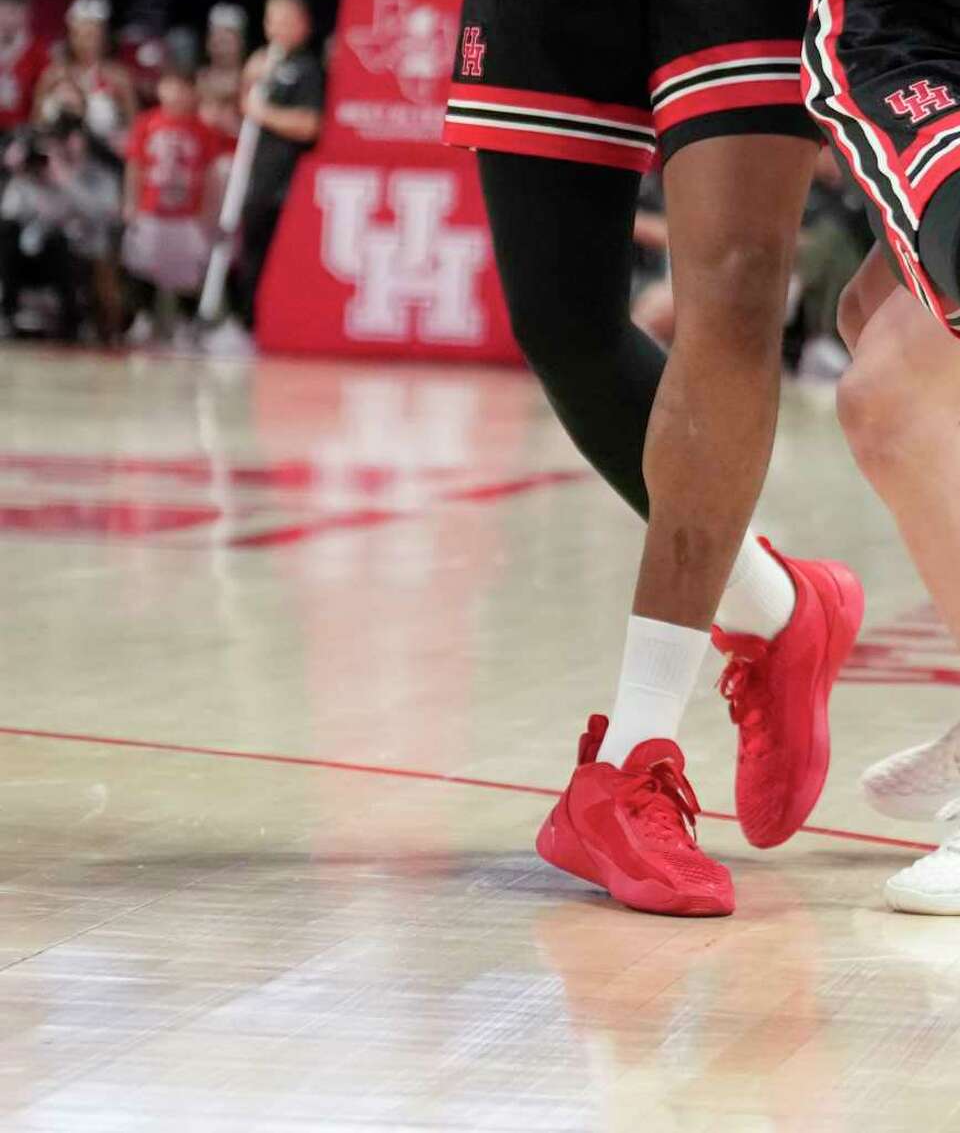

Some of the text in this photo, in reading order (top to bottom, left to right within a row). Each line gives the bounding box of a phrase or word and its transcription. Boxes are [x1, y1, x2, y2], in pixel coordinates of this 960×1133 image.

[462, 26, 485, 76] UH
[884, 79, 956, 123] UH
[314, 165, 487, 345] UH
